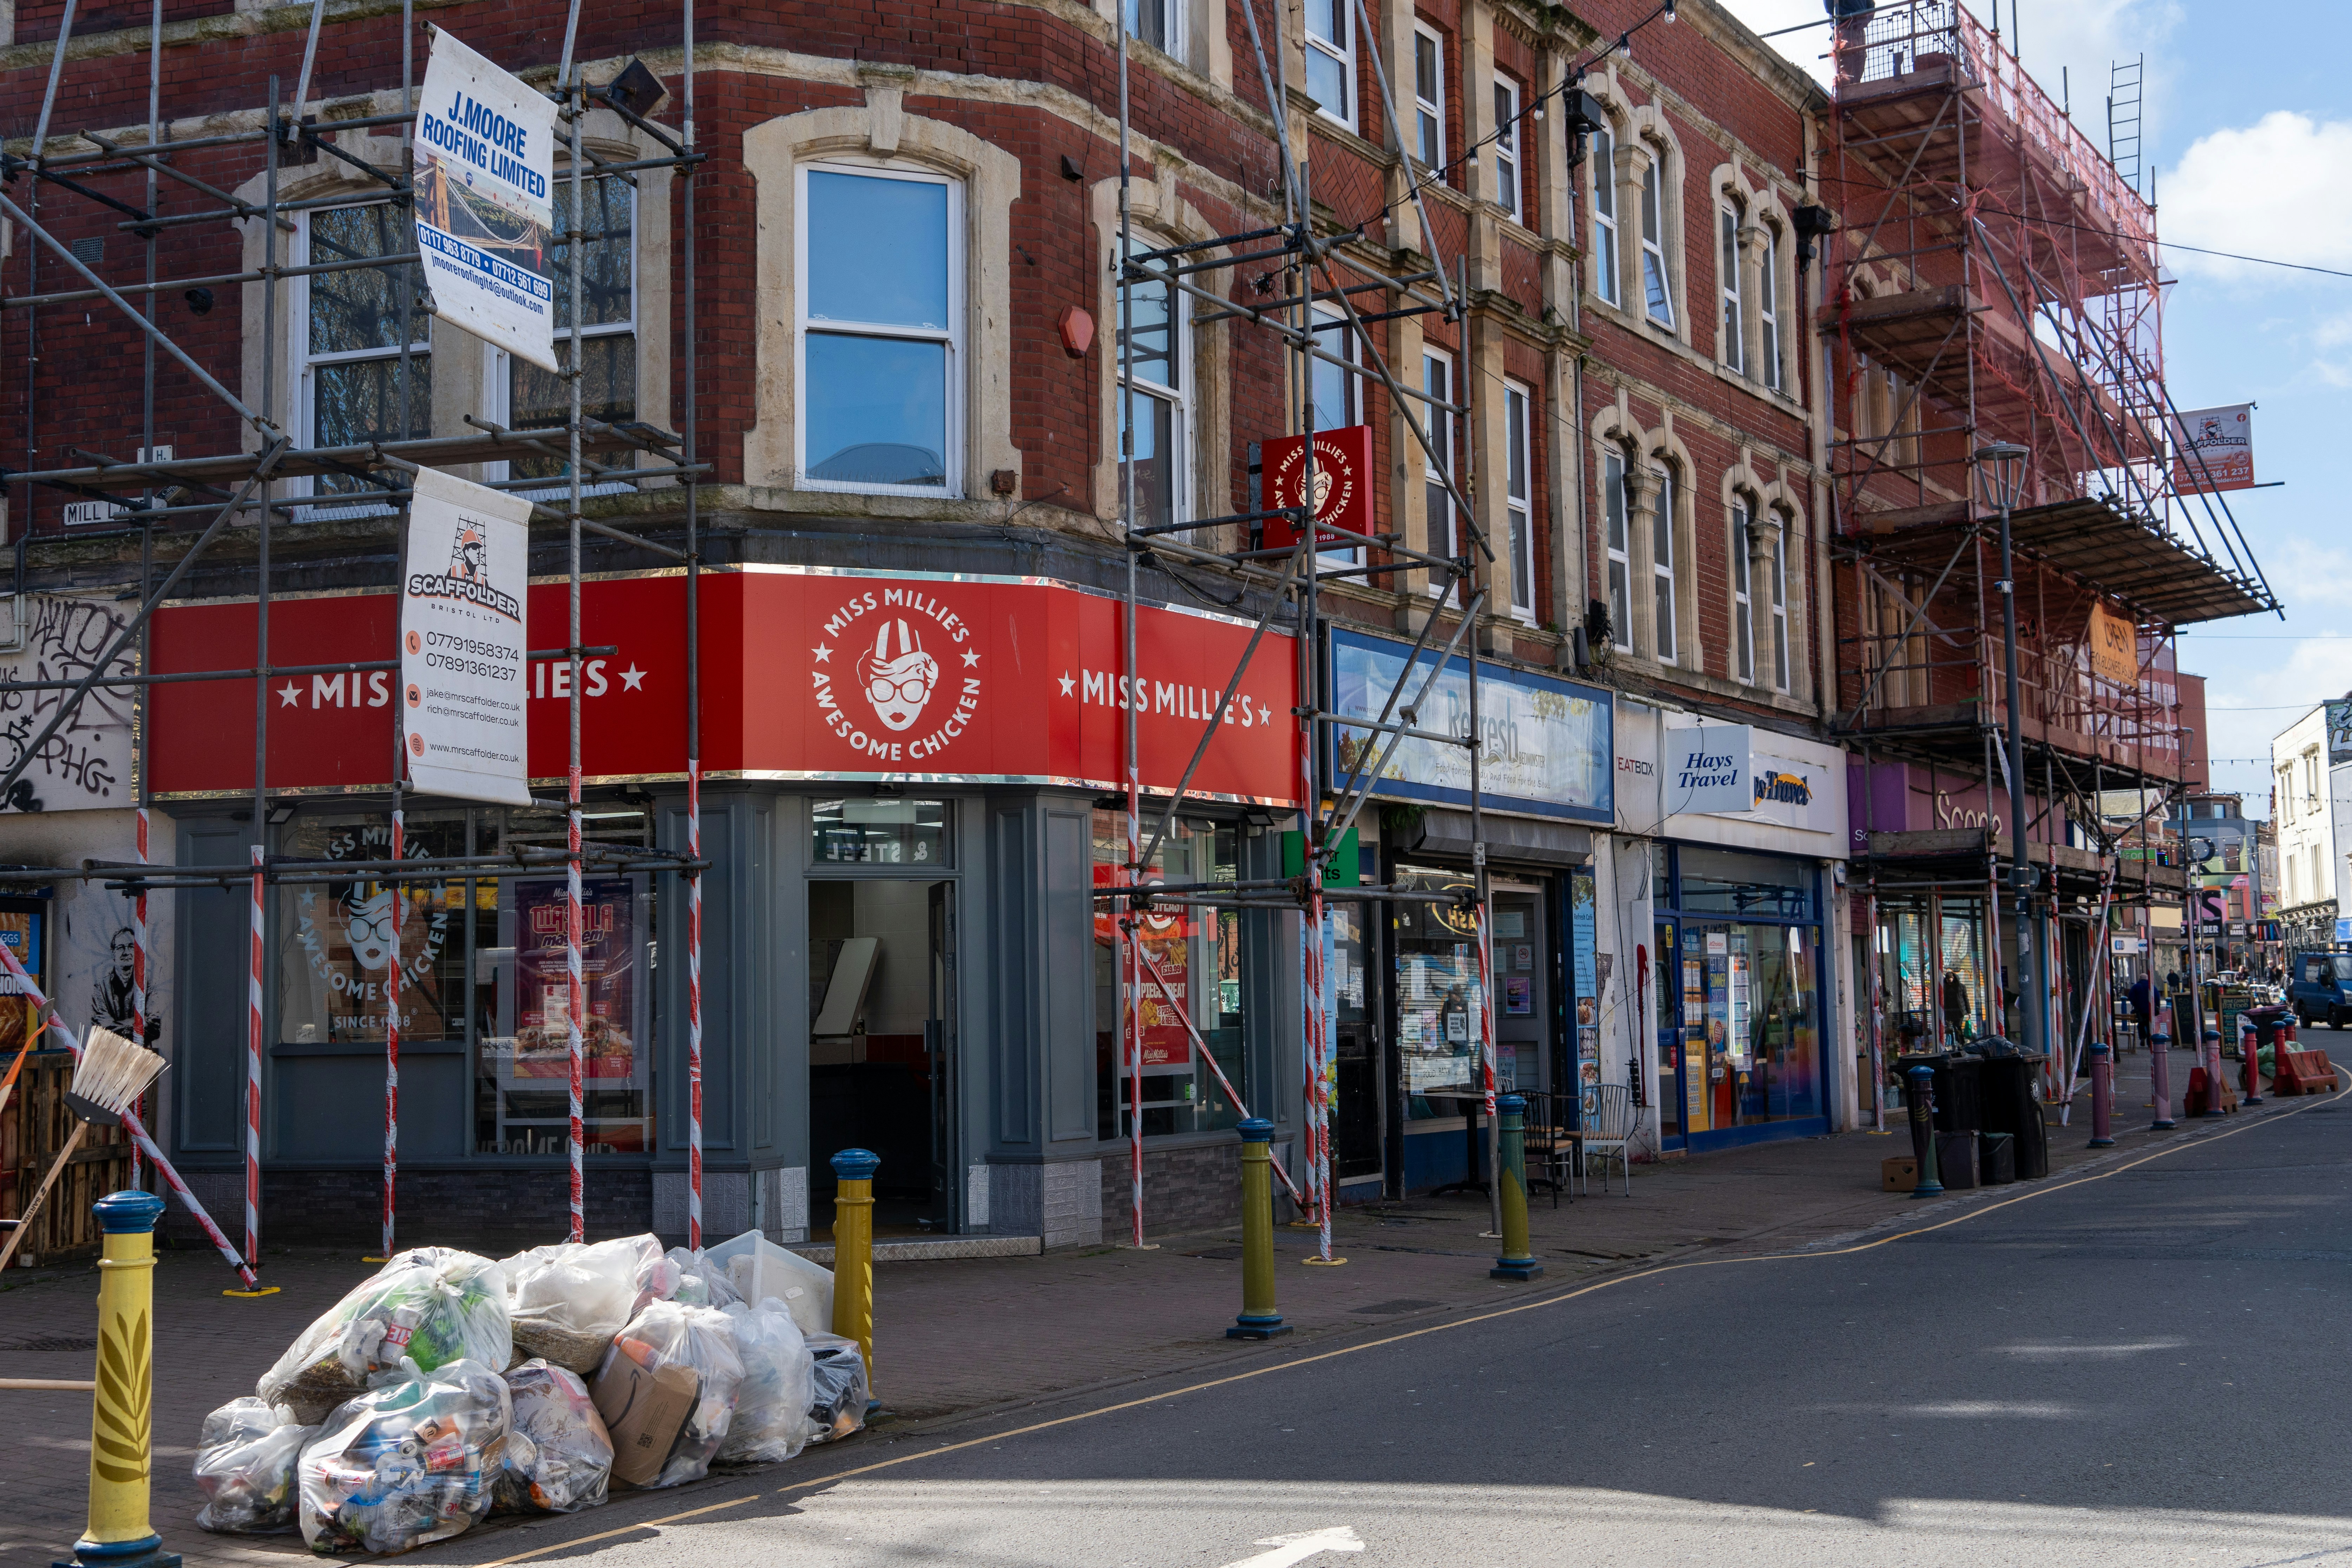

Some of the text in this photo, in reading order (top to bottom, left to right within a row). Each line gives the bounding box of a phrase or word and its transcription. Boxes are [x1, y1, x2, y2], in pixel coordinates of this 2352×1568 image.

[448, 91, 526, 159] J.MOORE
[423, 112, 545, 198] ROOFING LIMITED
[420, 227, 548, 298] 0117 963 8779 07712 561 699
[431, 251, 544, 315] jmooreroofingltd@outlook.com
[1279, 445, 1304, 472] MISS
[2211, 469, 2227, 478] 361
[2231, 467, 2249, 476] 237
[68, 505, 101, 523] MILL
[409, 577, 518, 618] SCAFFOLDER
[431, 603, 500, 624] BRISTOL LTD
[824, 588, 970, 643] MISS MILLIE'S
[426, 631, 519, 662] 07791958374
[426, 652, 516, 681] 07891361237
[426, 688, 520, 711] jake@mrscaffolder.co.uk
[1083, 669, 1149, 713] MISS
[427, 704, 519, 727] rich@mrscaffolder.co.uk
[812, 671, 981, 761] AWESOME CHICKEN
[430, 743, 519, 763] www.mrscaffolder.co.uk
[1519, 751, 1545, 768] BEDMINSTER
[1686, 752, 1733, 771] Hays
[1436, 763, 1450, 772] Food
[1452, 766, 1461, 777] for
[1462, 767, 1471, 776] the
[1490, 773, 1501, 781] and
[1503, 774, 1516, 783] Food
[1518, 775, 1526, 788] for
[1528, 778, 1536, 787] the
[1678, 769, 1737, 788] Travel
[1766, 769, 1809, 806] Travel
[300, 916, 376, 1000] AWESOME
[1717, 957, 1725, 972] THIS
[1162, 966, 1181, 974] £19.99
[1710, 973, 1725, 988] SUMMER
[1711, 989, 1725, 1003] SORTED
[335, 1015, 375, 1029] SINCE
[1143, 1049, 1168, 1060] Miss Millie's
[1423, 1067, 1450, 1078] FOOD BANK
